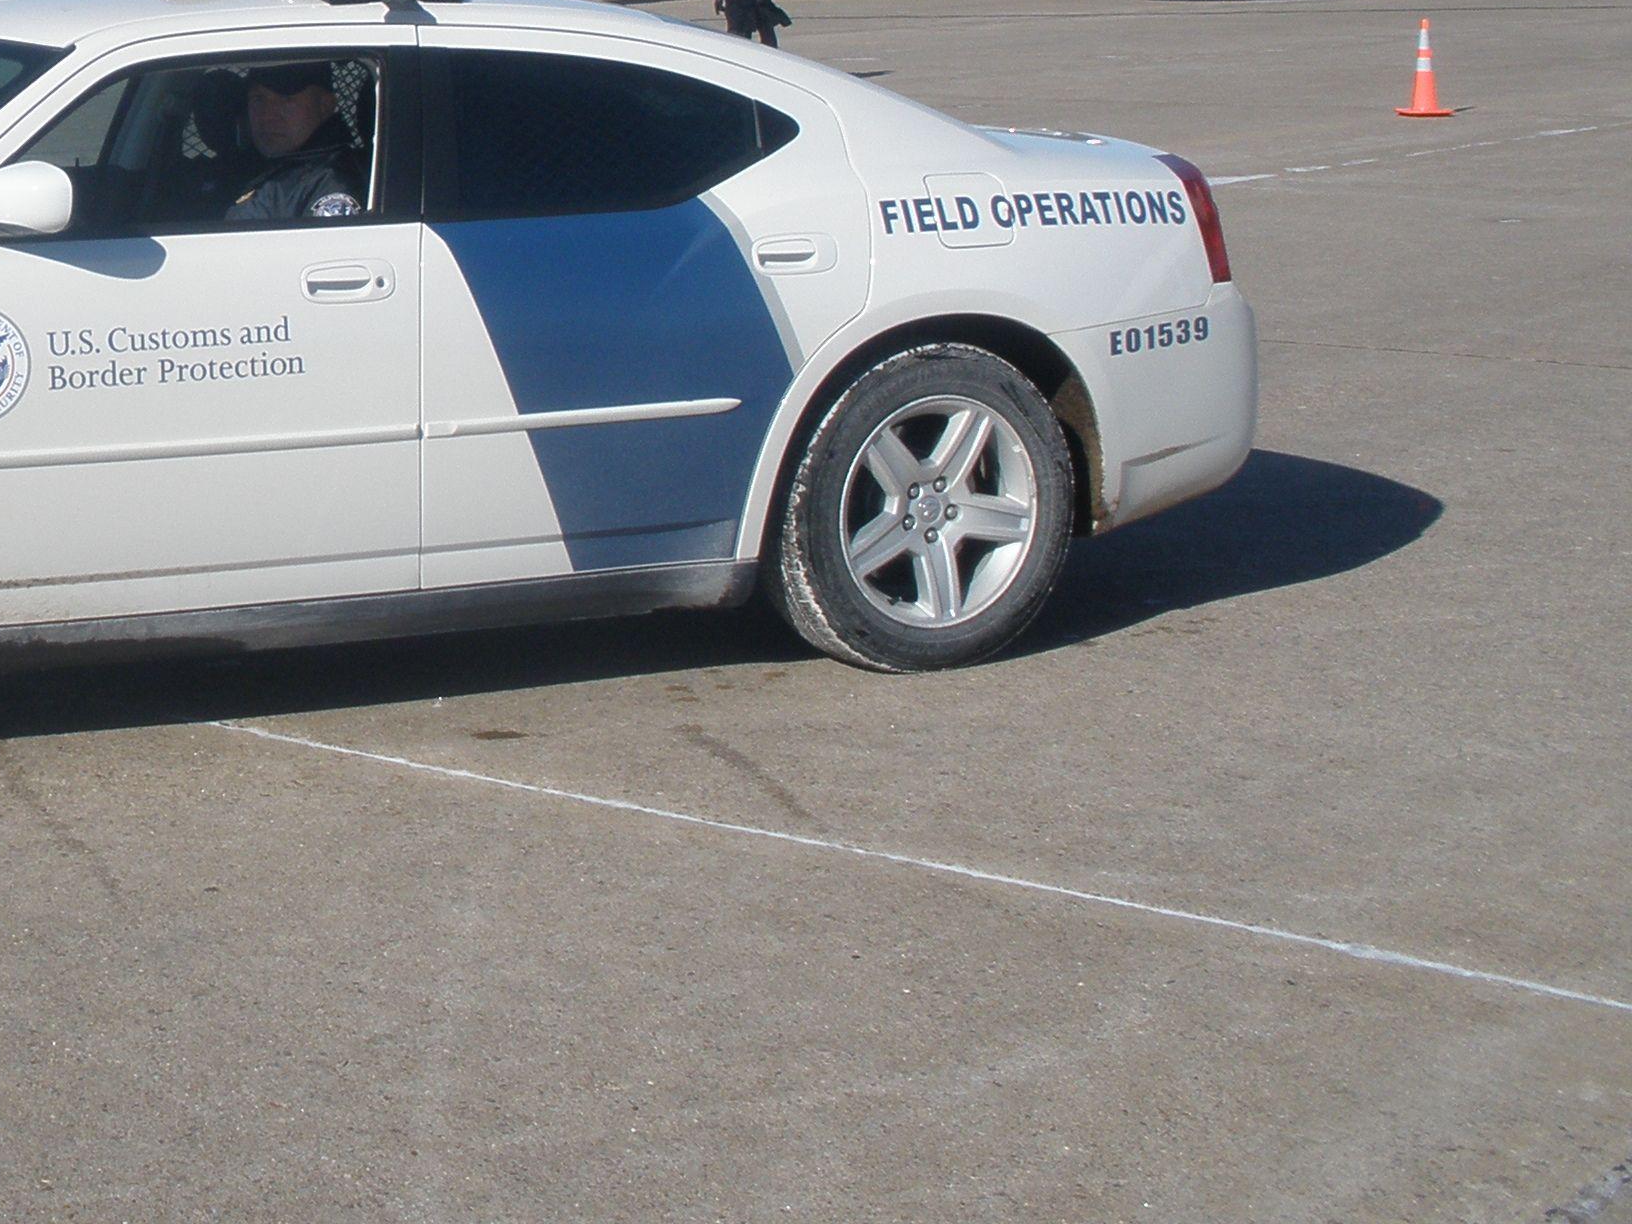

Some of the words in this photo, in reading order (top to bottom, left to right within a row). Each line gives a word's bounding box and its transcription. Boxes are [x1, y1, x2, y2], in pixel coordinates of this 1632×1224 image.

[878, 196, 980, 235] FIELD
[990, 190, 1186, 229] OPERATIONS
[13, 343, 25, 358] OF
[46, 329, 101, 357] U.S.
[107, 326, 232, 353] Customs
[239, 315, 292, 345] and
[1109, 316, 1209, 356] E01539
[47, 359, 148, 391] Border
[157, 351, 306, 384] Protection
